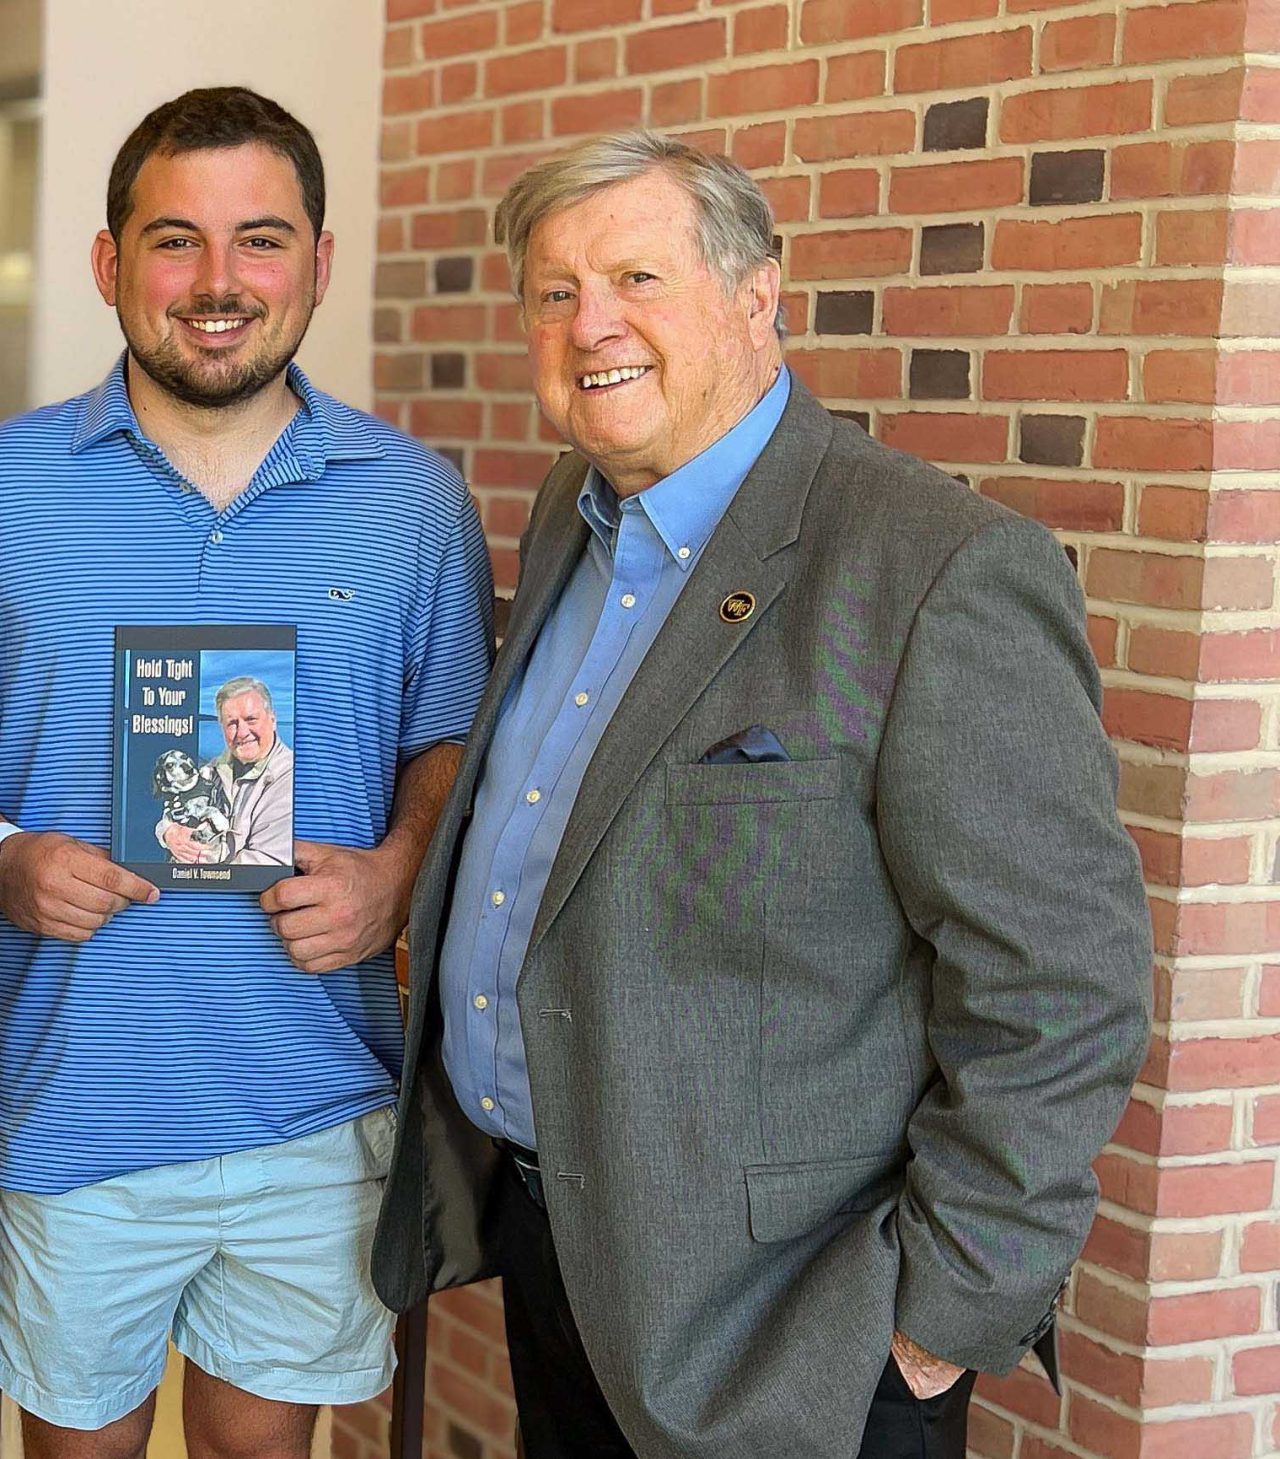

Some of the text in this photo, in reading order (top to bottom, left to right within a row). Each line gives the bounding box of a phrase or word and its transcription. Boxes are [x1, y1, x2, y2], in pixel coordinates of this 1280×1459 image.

[136, 659, 193, 681] Hold Tight
[142, 687, 186, 706] To Your
[132, 714, 194, 736] Blessings!
[172, 868, 193, 879] Daniel
[200, 868, 231, 880] Townsend
